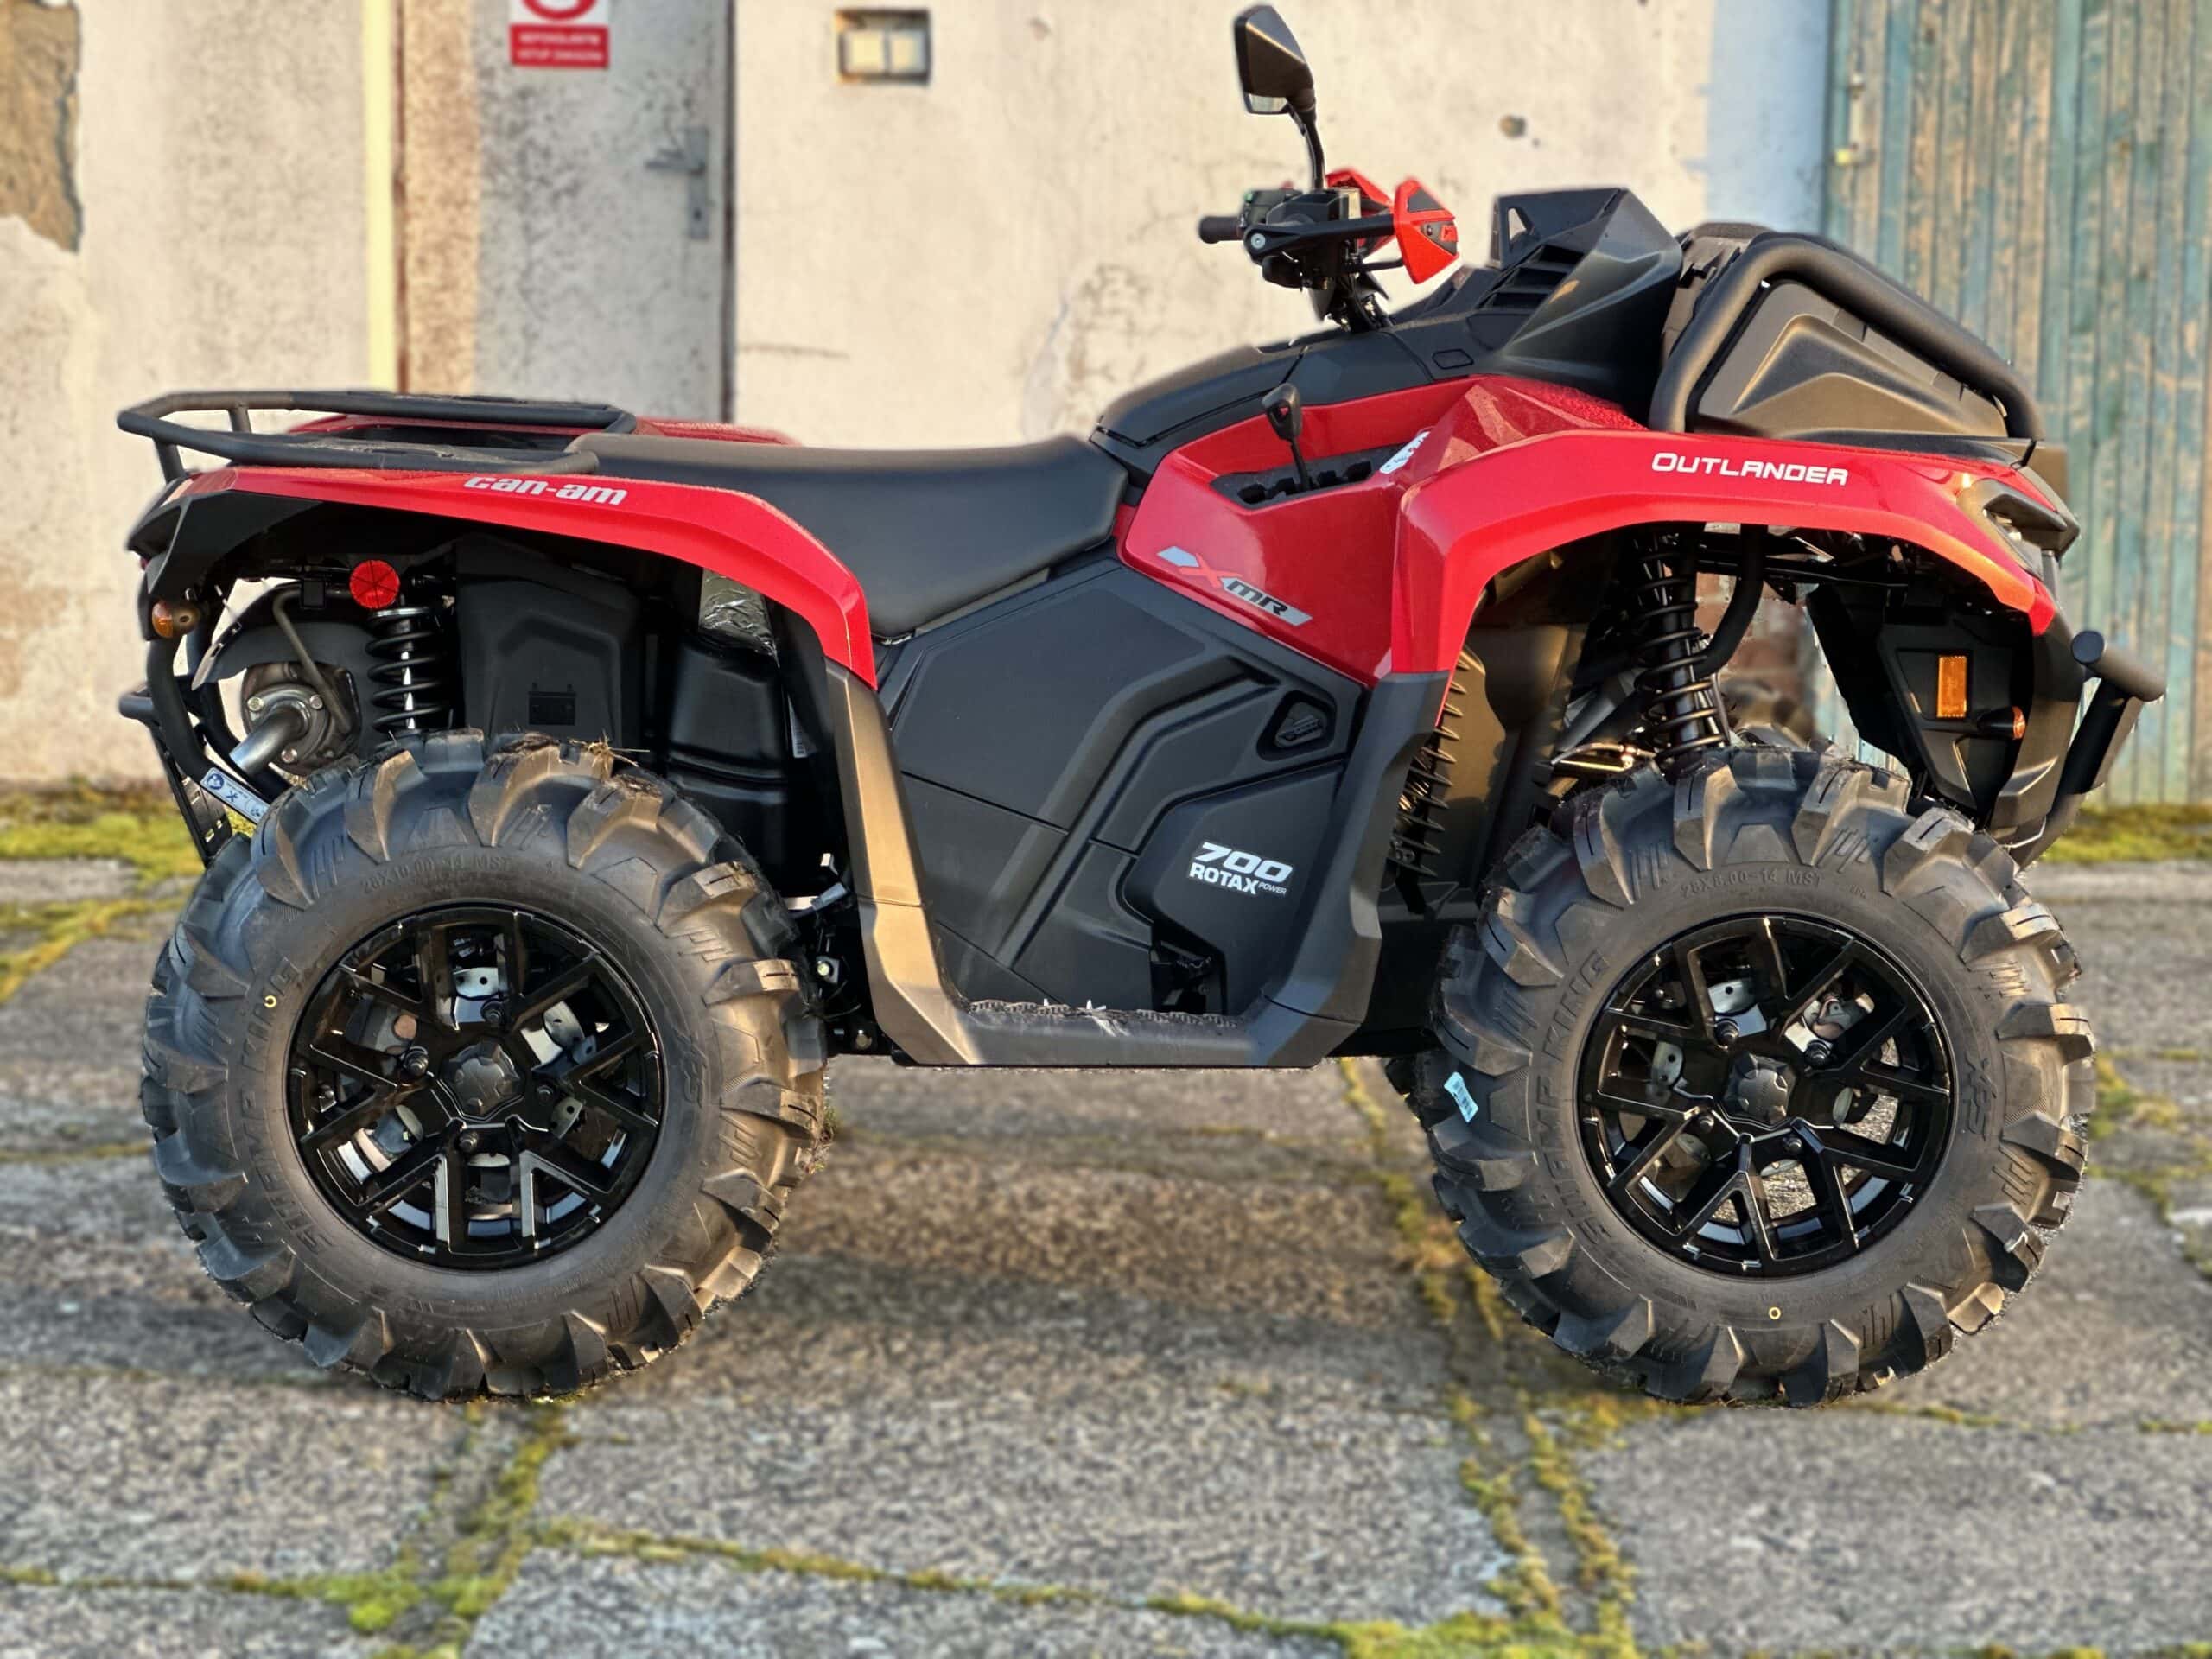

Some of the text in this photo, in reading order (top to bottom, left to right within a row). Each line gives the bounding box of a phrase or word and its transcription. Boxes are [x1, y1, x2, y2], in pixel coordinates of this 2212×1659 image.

[1652, 453, 1848, 486] OUTLANDER
[464, 477, 627, 505] can-am
[1189, 862, 1287, 895] ROTAX POWER
[1195, 842, 1293, 883] 700
